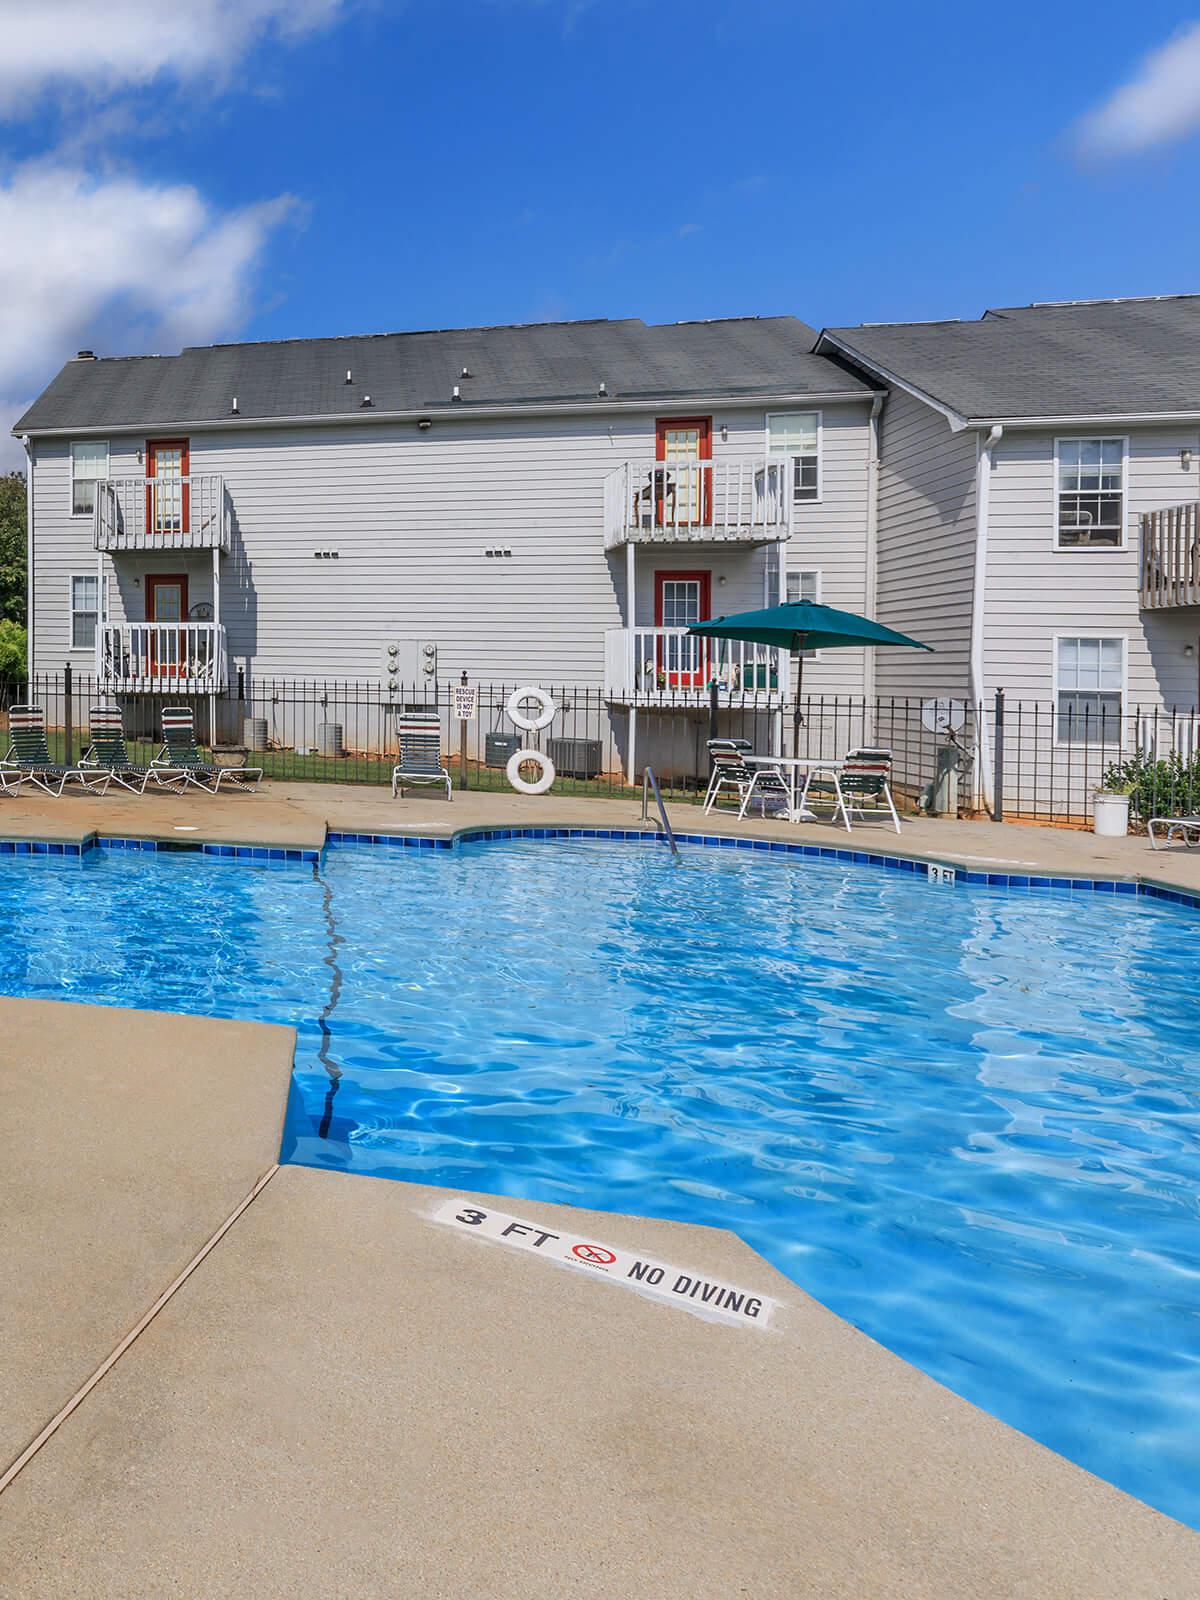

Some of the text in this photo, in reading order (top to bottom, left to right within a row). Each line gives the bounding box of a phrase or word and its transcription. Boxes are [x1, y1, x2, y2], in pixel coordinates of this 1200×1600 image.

[455, 1208, 487, 1226] 3
[500, 1222, 560, 1249] FT
[627, 1261, 665, 1286] NO
[671, 1275, 763, 1319] DIVING
